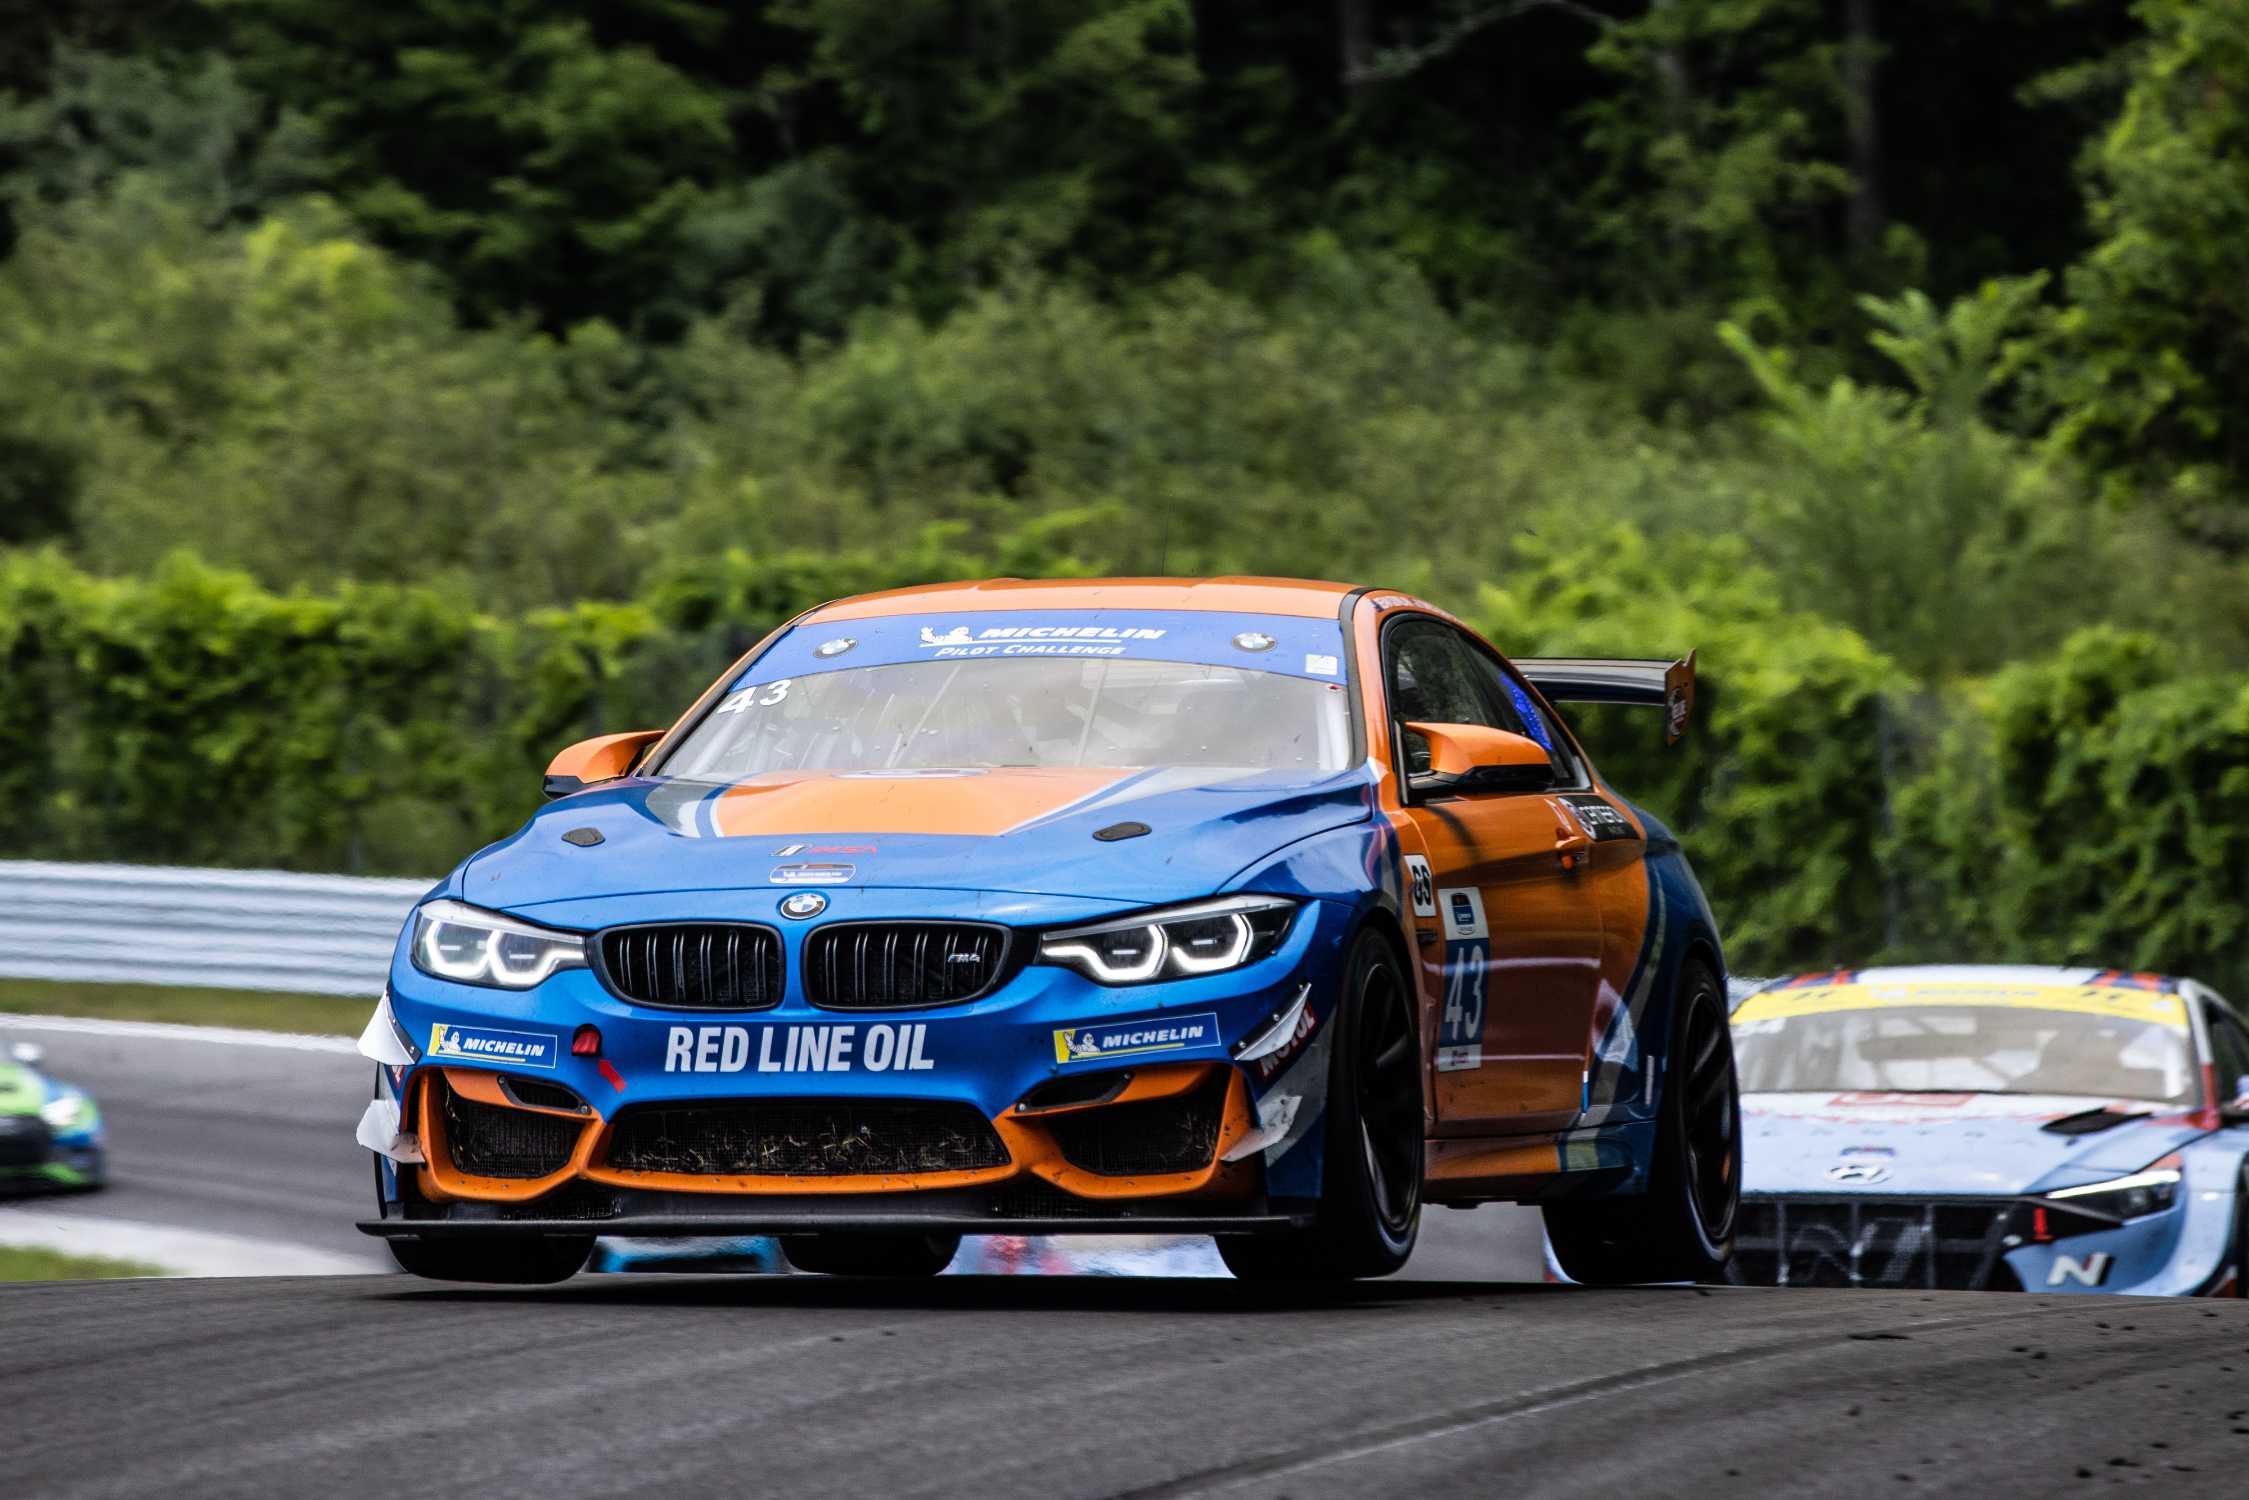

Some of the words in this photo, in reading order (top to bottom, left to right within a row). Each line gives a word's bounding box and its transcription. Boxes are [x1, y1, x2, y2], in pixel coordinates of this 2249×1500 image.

[979, 627, 1168, 640] MICHELIN
[935, 646, 1002, 657] PILOT
[1003, 644, 1127, 656] CHALLENGE
[717, 679, 791, 715] 43
[1412, 864, 1432, 906] GS
[1444, 945, 1485, 1040] 43
[463, 1036, 545, 1057] MICHELIN
[664, 1026, 750, 1073] RED
[757, 1026, 856, 1072] LINE
[863, 1024, 935, 1072] OIL
[1102, 1025, 1204, 1049] MICHELIN
